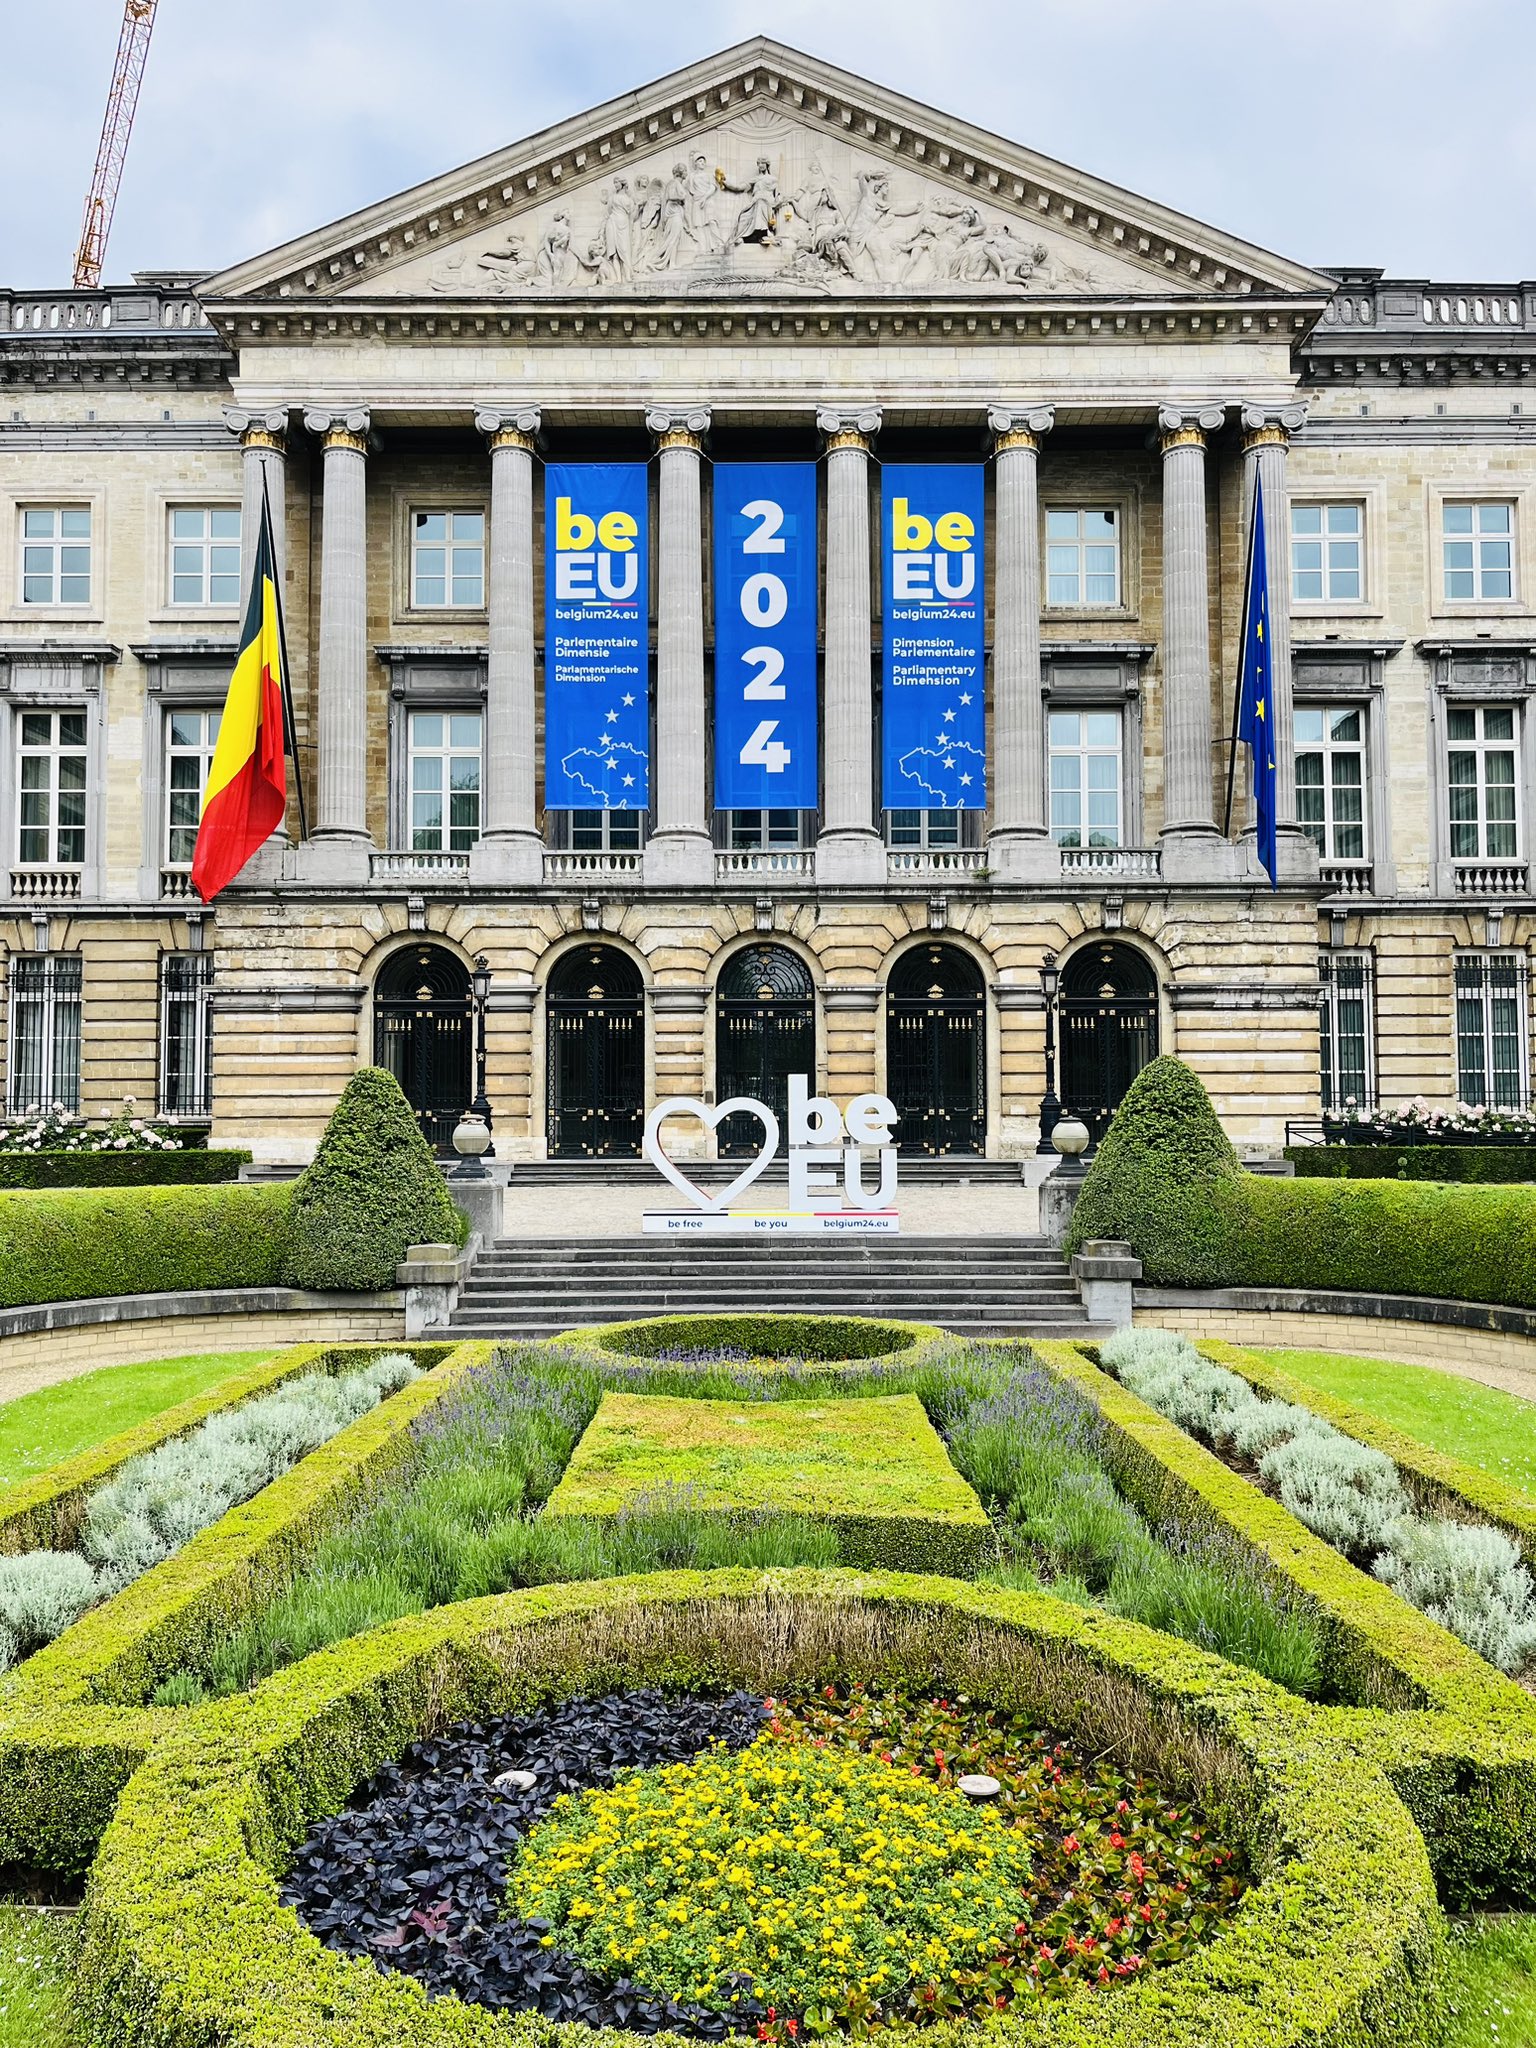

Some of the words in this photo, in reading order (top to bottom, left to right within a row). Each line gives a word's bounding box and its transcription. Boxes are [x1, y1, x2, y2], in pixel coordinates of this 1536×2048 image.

[555, 497, 639, 551] be
[892, 497, 975, 551] be
[555, 553, 638, 599] EU
[892, 553, 975, 599] EU
[555, 608, 638, 621] belgium24.eu
[892, 608, 976, 621] belgium24.eu
[555, 636, 639, 648] Parlementaire
[892, 637, 955, 648] Dimension
[555, 647, 610, 657] Dimensie
[892, 646, 976, 657] Parlementaire
[555, 665, 639, 674] Parlamentarische
[892, 664, 976, 678] Parliamentary
[555, 673, 606, 683] Dimension
[892, 675, 961, 686] Dimension
[788, 1074, 898, 1144] be
[788, 1149, 898, 1210] EU
[668, 1219, 681, 1228] be
[683, 1219, 703, 1228] free
[754, 1219, 767, 1228] be
[769, 1220, 788, 1230] you
[823, 1219, 889, 1229] belgium24.eu
